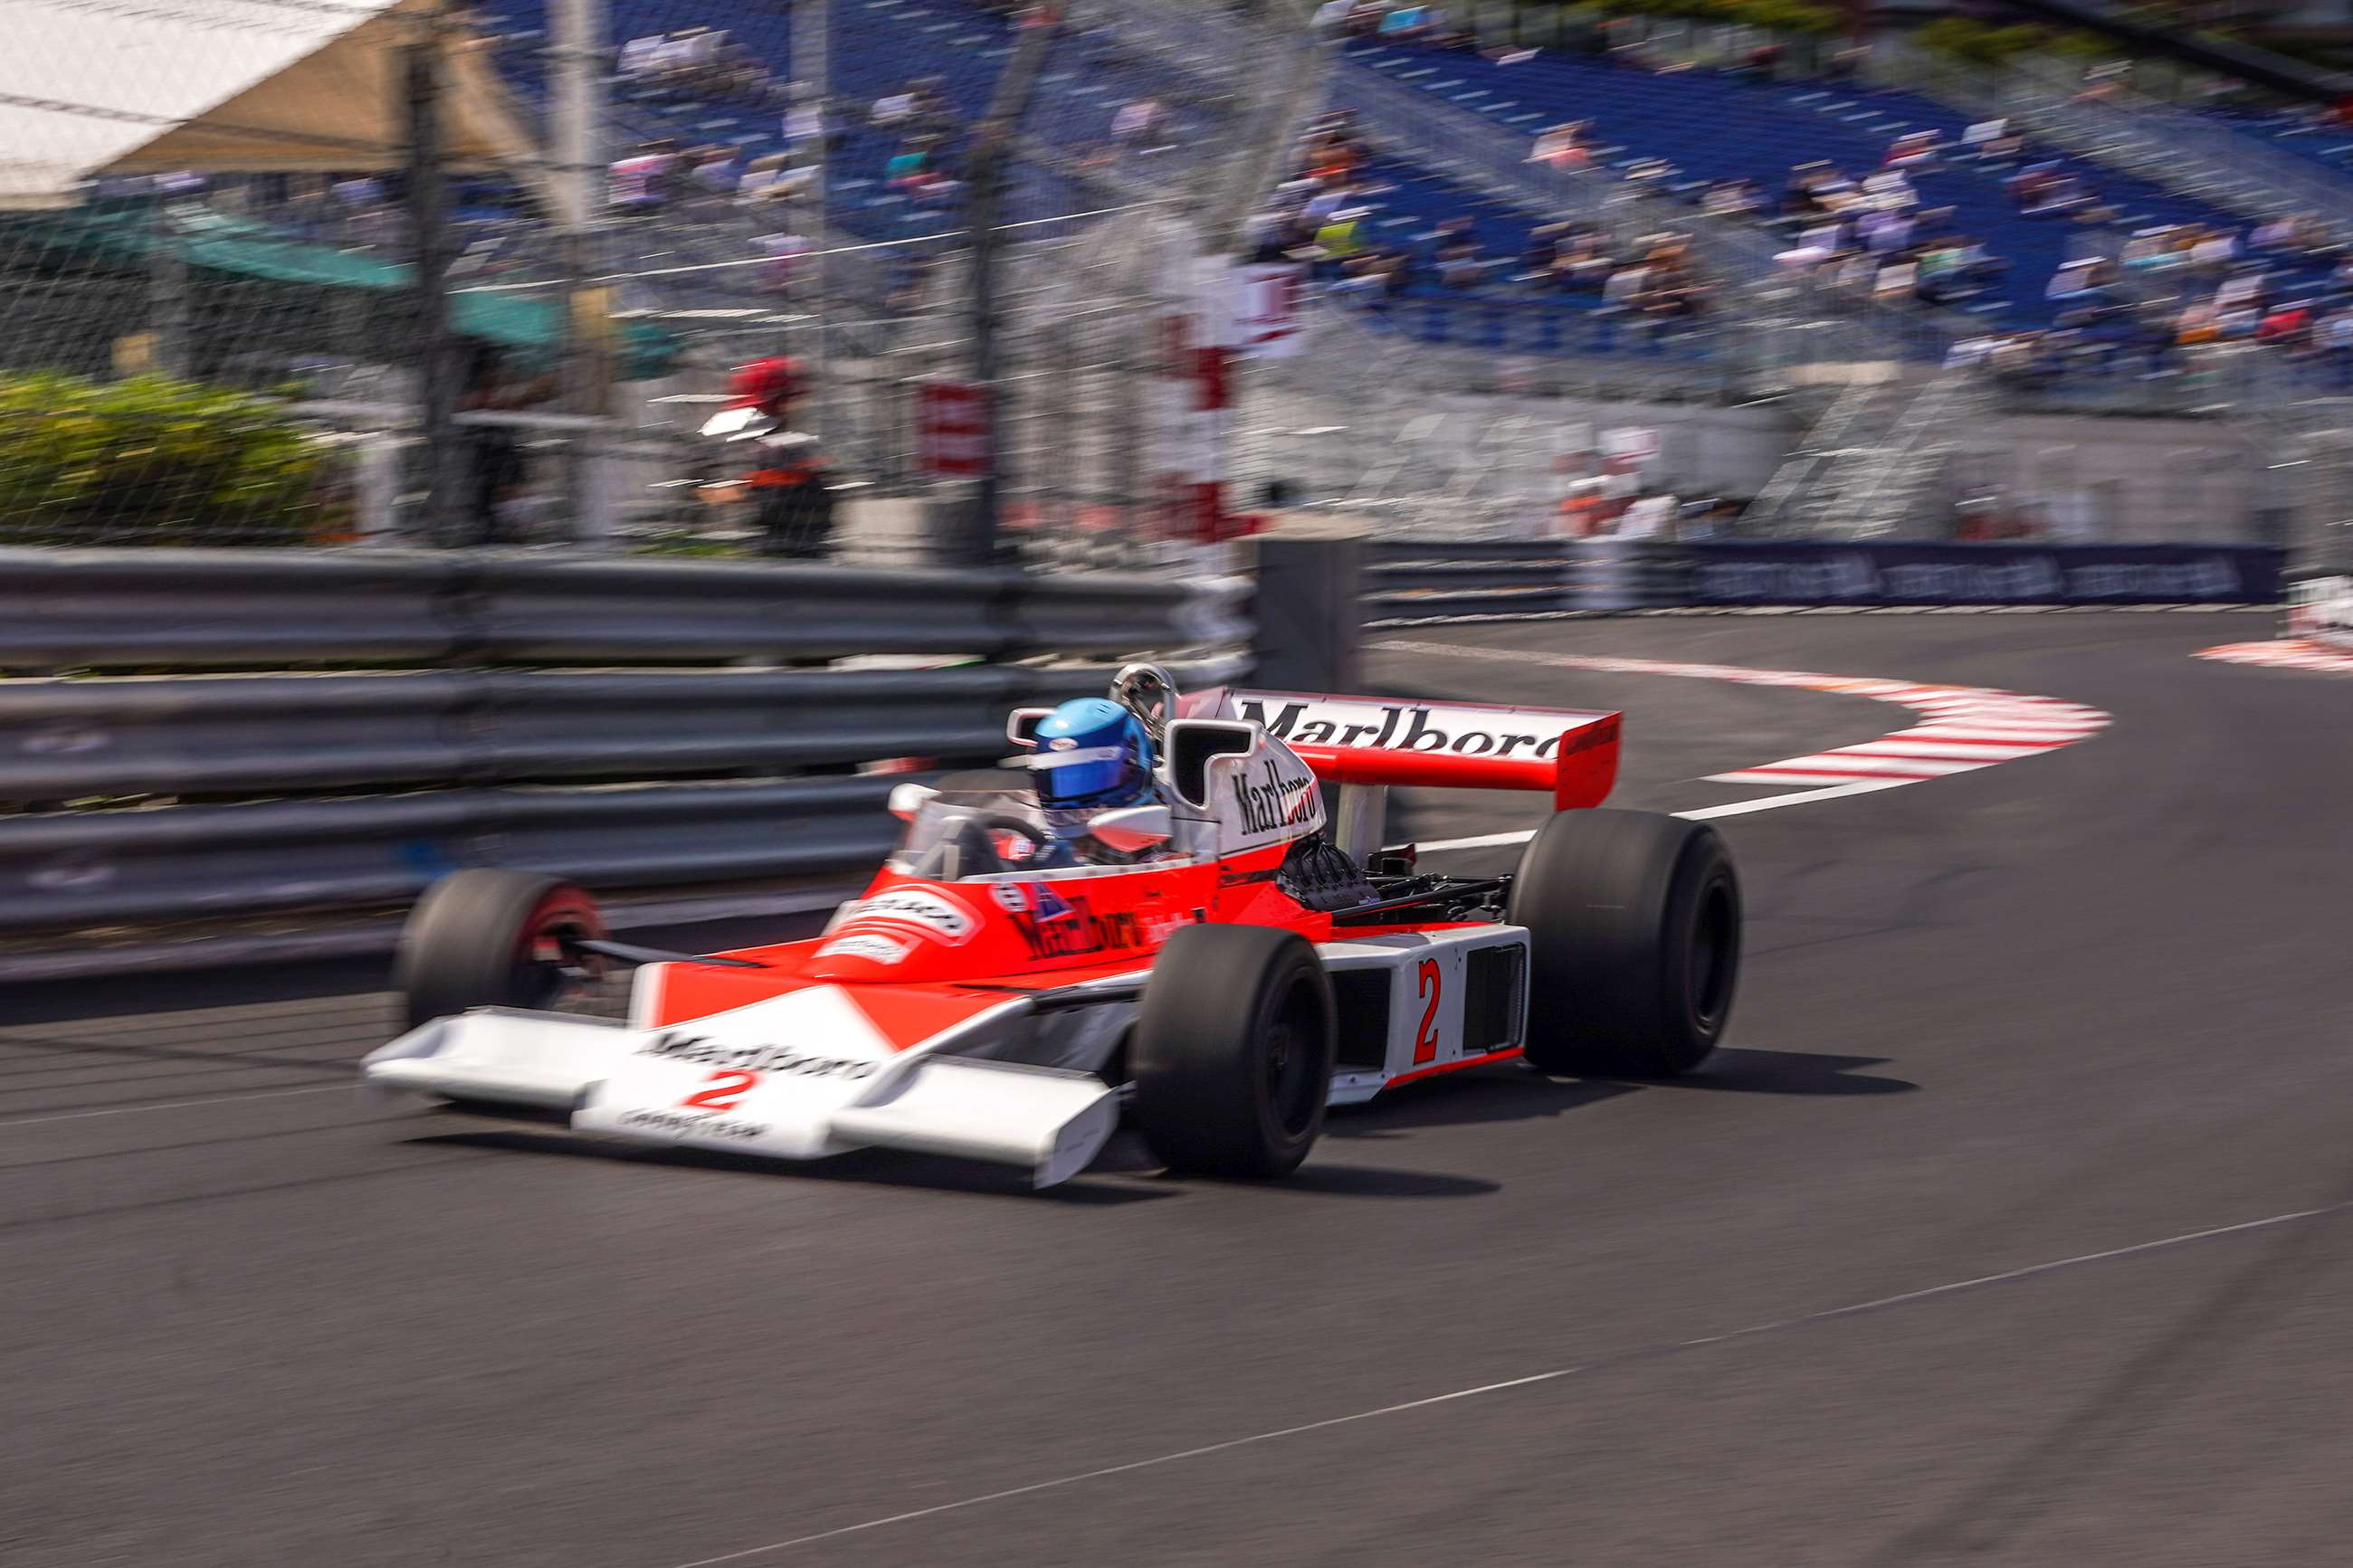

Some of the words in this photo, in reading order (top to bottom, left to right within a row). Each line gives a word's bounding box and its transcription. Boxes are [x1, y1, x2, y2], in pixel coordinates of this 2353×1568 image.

[1232, 759, 1316, 835] Marlboro
[1413, 957, 1442, 1066] 2
[634, 1031, 881, 1080] Marlboro
[681, 1069, 762, 1111] 2
